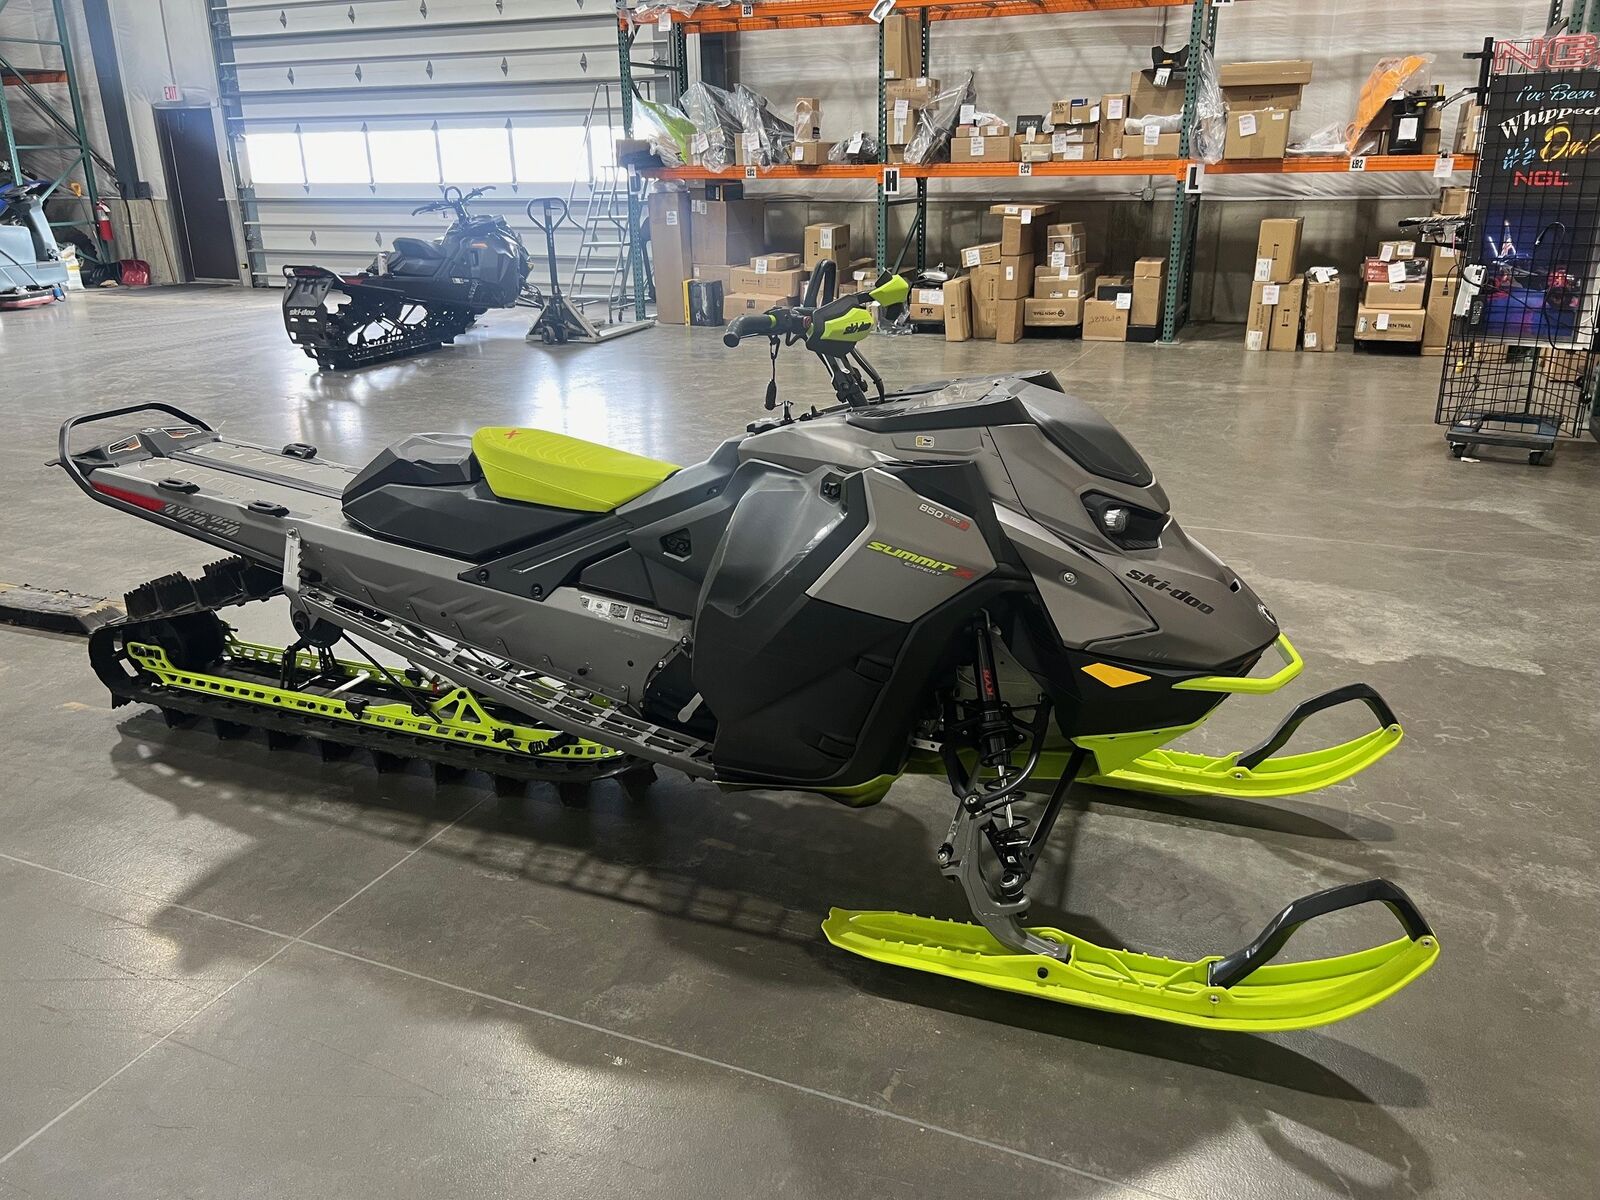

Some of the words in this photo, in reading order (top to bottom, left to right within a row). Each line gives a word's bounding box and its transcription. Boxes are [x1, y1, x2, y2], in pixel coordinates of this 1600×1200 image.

[1494, 35, 1600, 72] NG
[163, 86, 178, 101] EXIT
[1550, 83, 1597, 101] Been
[885, 170, 898, 192] H
[1189, 166, 1199, 190] L
[1513, 170, 1569, 187] NGL
[843, 321, 872, 335] ski-doo
[919, 503, 944, 519] 850
[866, 540, 958, 573] SUMMIT
[903, 561, 942, 577] EXPERT
[1125, 568, 1216, 616] ski-doo
